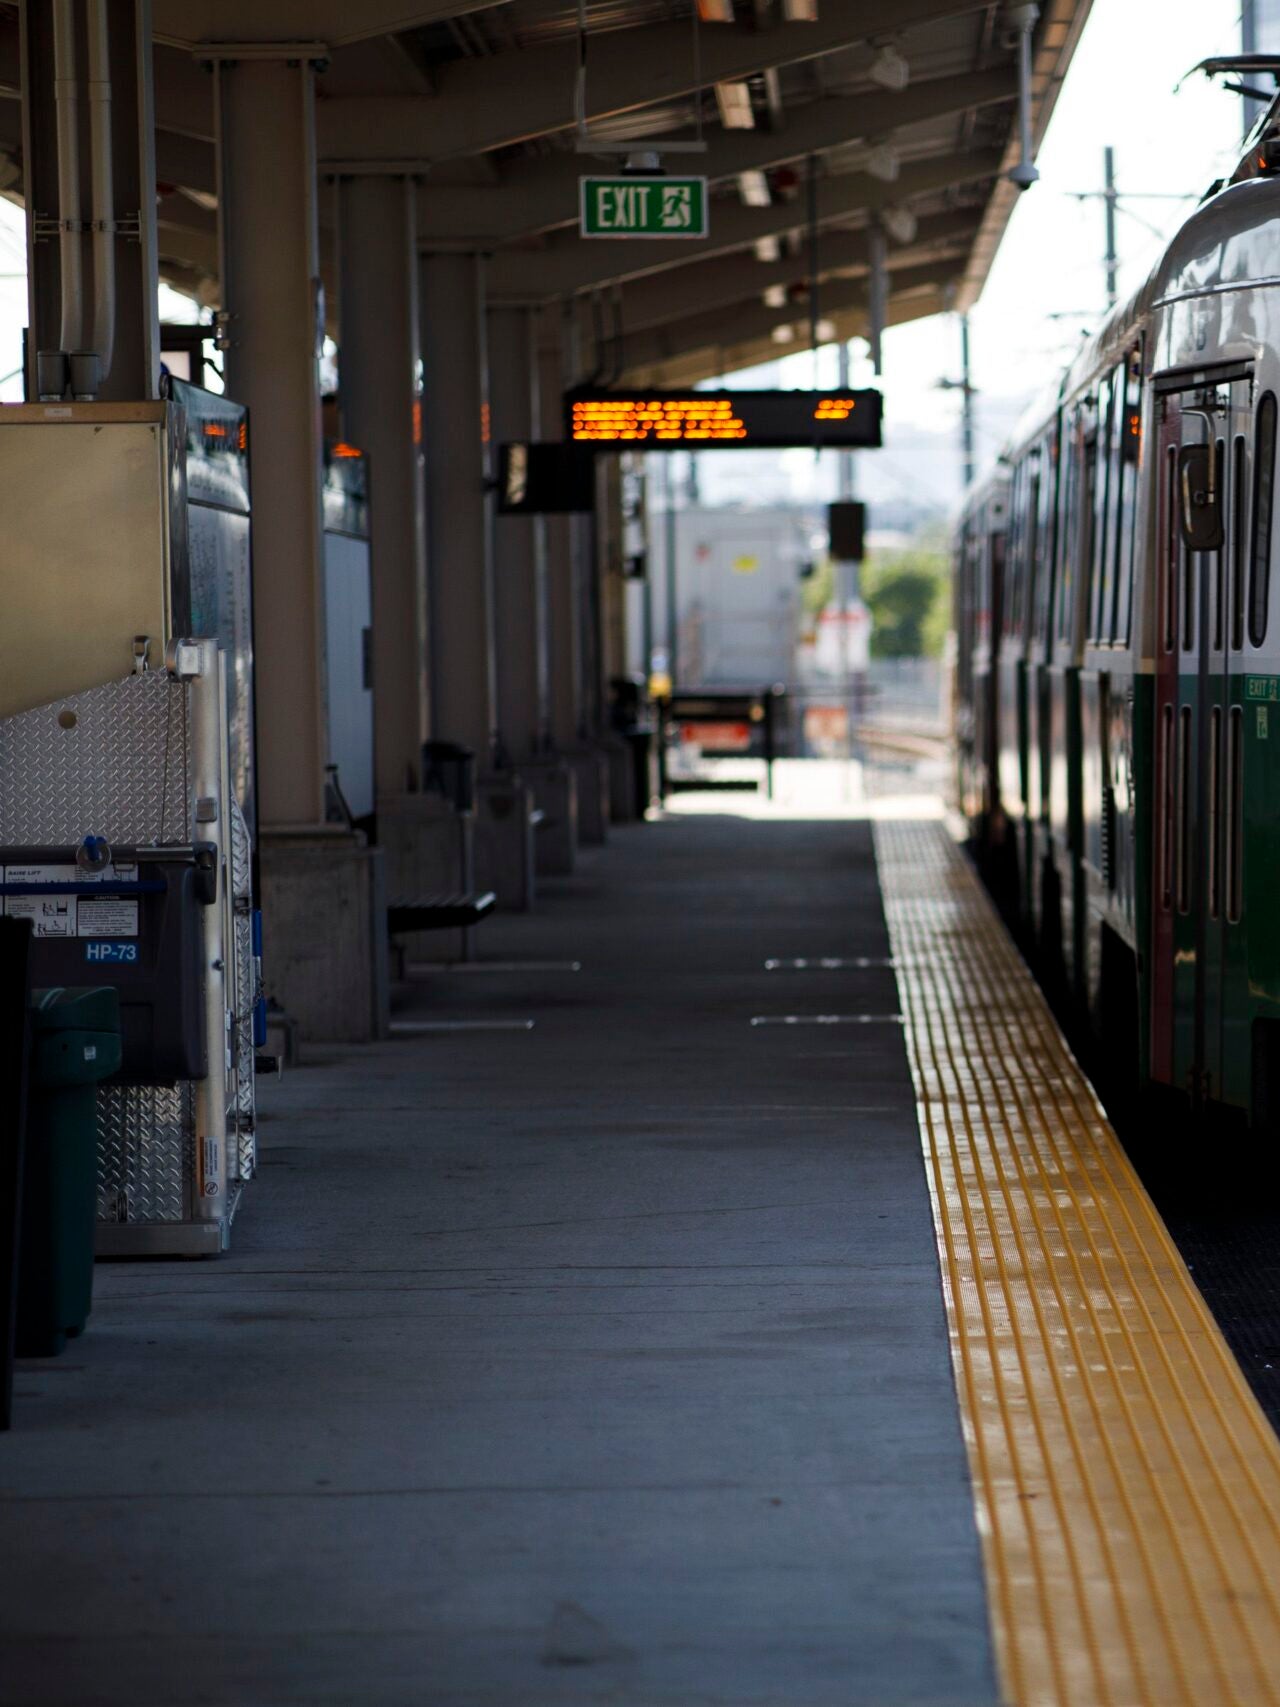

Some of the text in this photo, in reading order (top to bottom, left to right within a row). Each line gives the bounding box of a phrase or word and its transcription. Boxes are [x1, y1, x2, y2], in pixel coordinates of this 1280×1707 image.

[597, 186, 651, 228] EXIT
[1249, 679, 1267, 697] EXIT
[87, 944, 136, 960] HP-73
